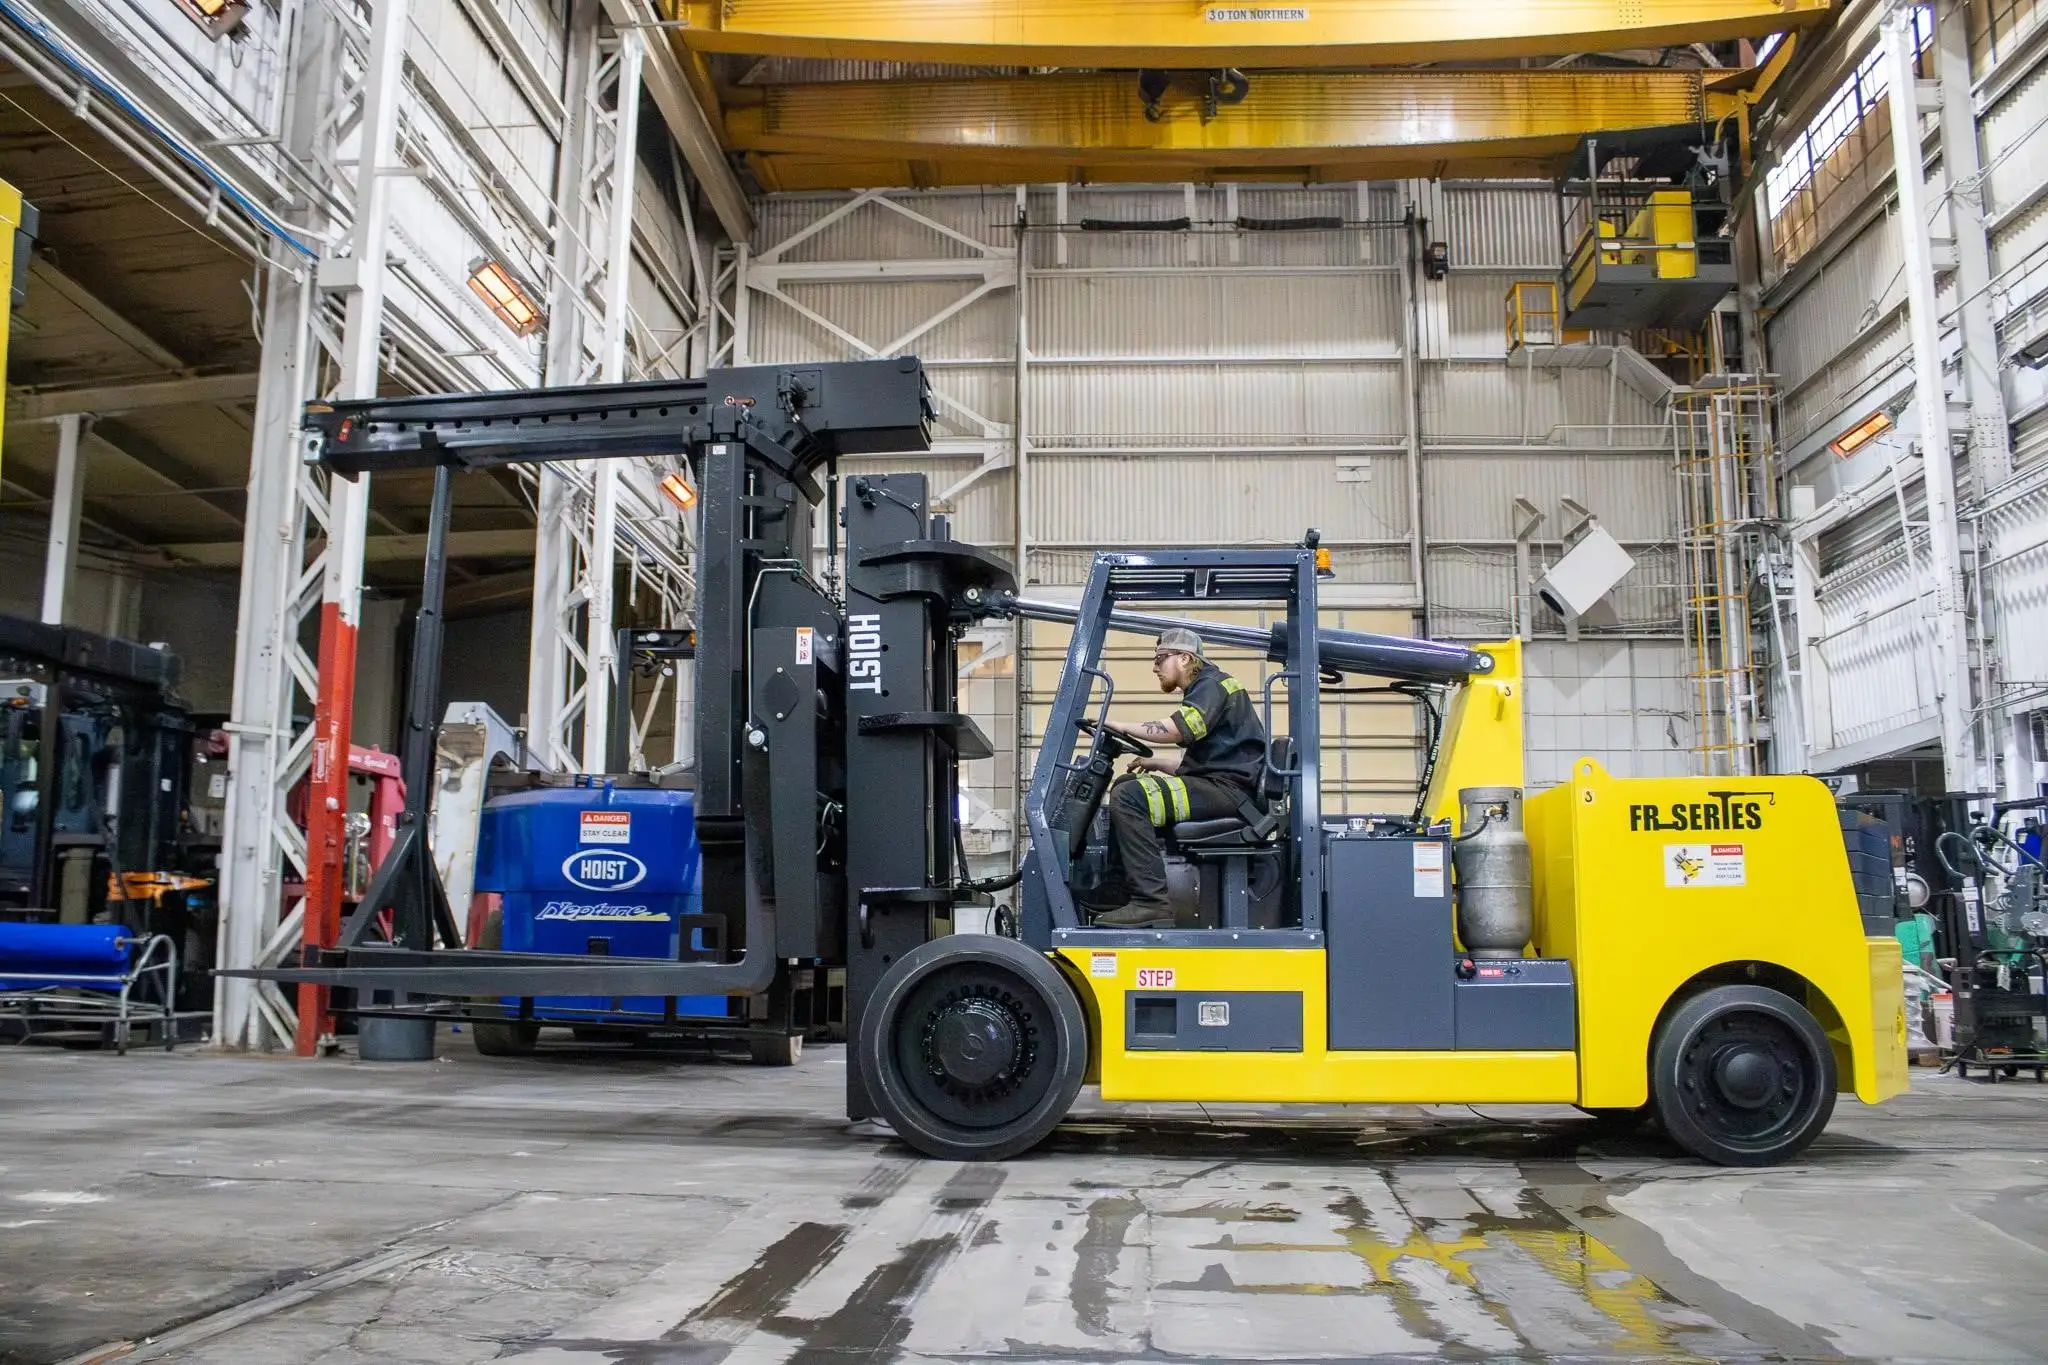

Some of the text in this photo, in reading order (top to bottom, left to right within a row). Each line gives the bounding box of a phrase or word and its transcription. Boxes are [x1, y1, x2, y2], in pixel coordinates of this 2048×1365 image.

[1228, 10, 1247, 20] TON
[1249, 9, 1304, 20] NORTHERN
[849, 614, 881, 694] HOIST
[582, 829, 600, 837] STAY
[580, 860, 628, 880] HOIST
[535, 901, 654, 921] Neptune
[1139, 969, 1173, 987] STEP
